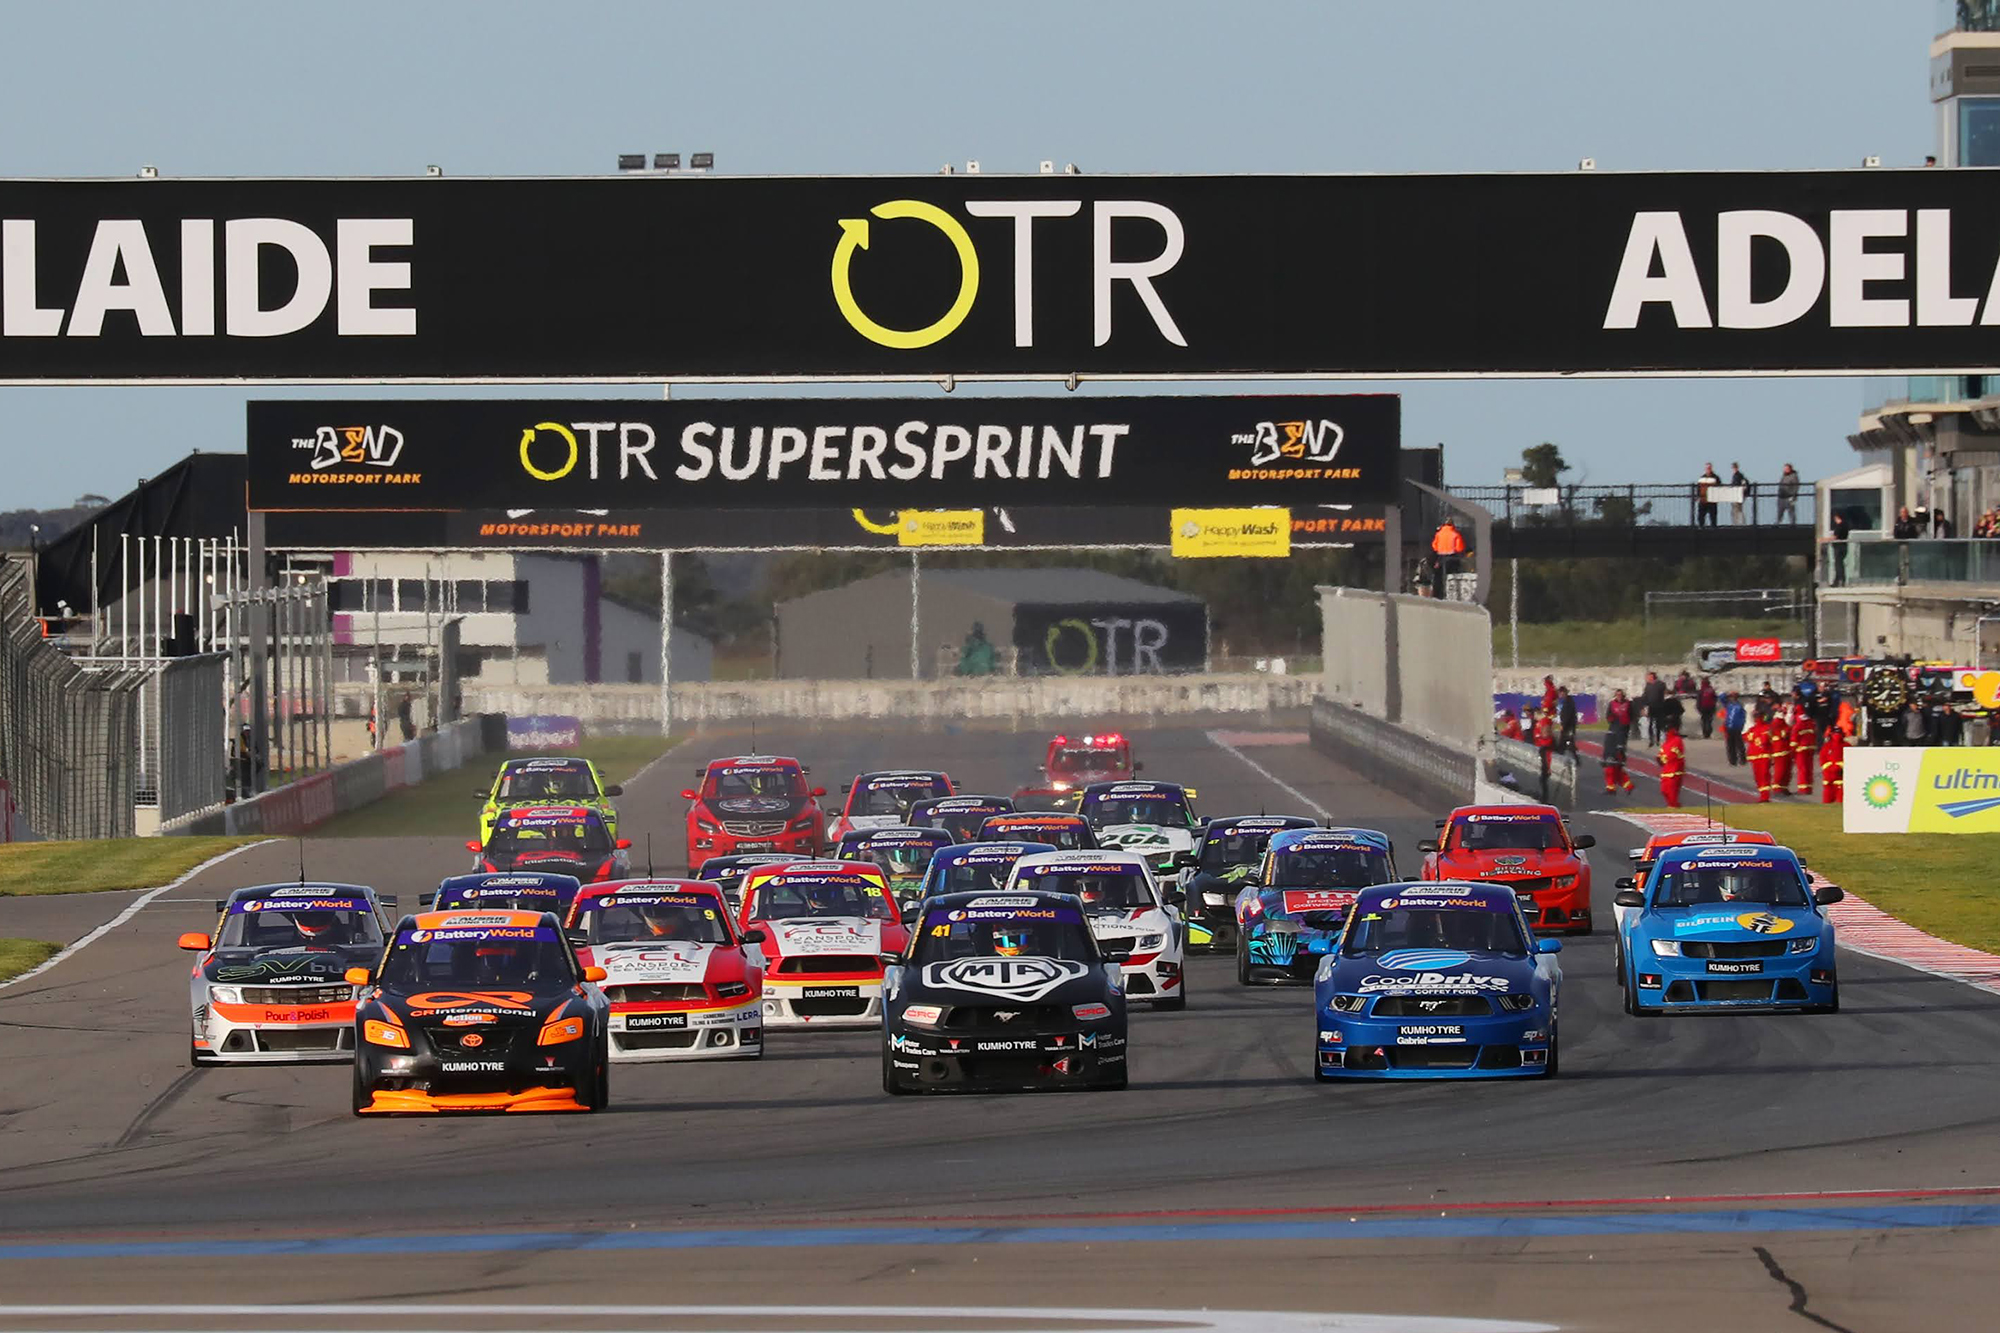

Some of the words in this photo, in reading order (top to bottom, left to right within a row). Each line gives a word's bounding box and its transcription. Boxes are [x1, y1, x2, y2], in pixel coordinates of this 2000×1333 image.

[1602, 209, 2000, 329] ADEL
[3, 217, 417, 337] LAIDE
[832, 200, 1188, 349] OTR
[292, 438, 315, 449] THE
[311, 424, 404, 470] BEND
[1231, 434, 1255, 445] THE
[1251, 419, 1344, 466] BEND
[520, 421, 658, 481] OTR
[675, 420, 1130, 482] SUPERSPRINT
[288, 473, 381, 485] MOTORSPORT
[384, 473, 421, 484] PARK
[1228, 469, 1321, 480] MOTORSPORT
[1324, 468, 1361, 479] PARK
[480, 523, 594, 537] MOTORSPORT
[597, 524, 642, 536] PARK
[1291, 519, 1338, 532] PORT
[1341, 519, 1385, 531] PARK
[1046, 617, 1169, 677] OTR
[1885, 760, 1900, 772] bp
[1934, 768, 2000, 789] ultim
[939, 805, 996, 814] BatteryWorld
[523, 818, 587, 826] BatteryWorld
[1010, 824, 1069, 832] BatteryWorld
[871, 840, 933, 848] BatteryWorld
[1304, 843, 1371, 851] BatteryWorld
[1049, 865, 1122, 873] BatteryWorld
[1697, 861, 1773, 869] BatteryWorld
[787, 876, 861, 885] BatteryWorld
[480, 888, 557, 897] BatteryWorld
[863, 887, 882, 897] 18
[263, 900, 353, 911] BatteryWorld
[617, 896, 697, 905] BatteryWorld
[1400, 898, 1487, 908] BatteryWorld
[703, 909, 715, 920] 9
[967, 910, 1055, 919] BatteryWorld
[1676, 916, 1736, 928] BILSTEIN
[434, 929, 535, 940] BatteryWorld
[931, 924, 951, 937] 41
[1709, 963, 1739, 971] KUMHO
[1740, 963, 1760, 971] TYRE
[269, 976, 302, 984] KUMHO
[303, 975, 325, 983] TYRE
[1360, 973, 1510, 987] CoolDrive
[805, 989, 835, 997] KUMHO
[836, 989, 857, 997] TYRE
[265, 1009, 330, 1021] Pour&Polish
[629, 1017, 661, 1027] KUMHO
[662, 1016, 685, 1025] TYRE
[1401, 1026, 1436, 1035] KUMHO
[1438, 1025, 1461, 1034] TYRE
[1396, 1036, 1428, 1045] Gabriel
[978, 1042, 1012, 1051] KUMHO
[1013, 1041, 1037, 1050] TYRE
[922, 1048, 936, 1056] Care
[442, 1062, 479, 1071] KUMHO
[480, 1062, 504, 1071] TYRE
